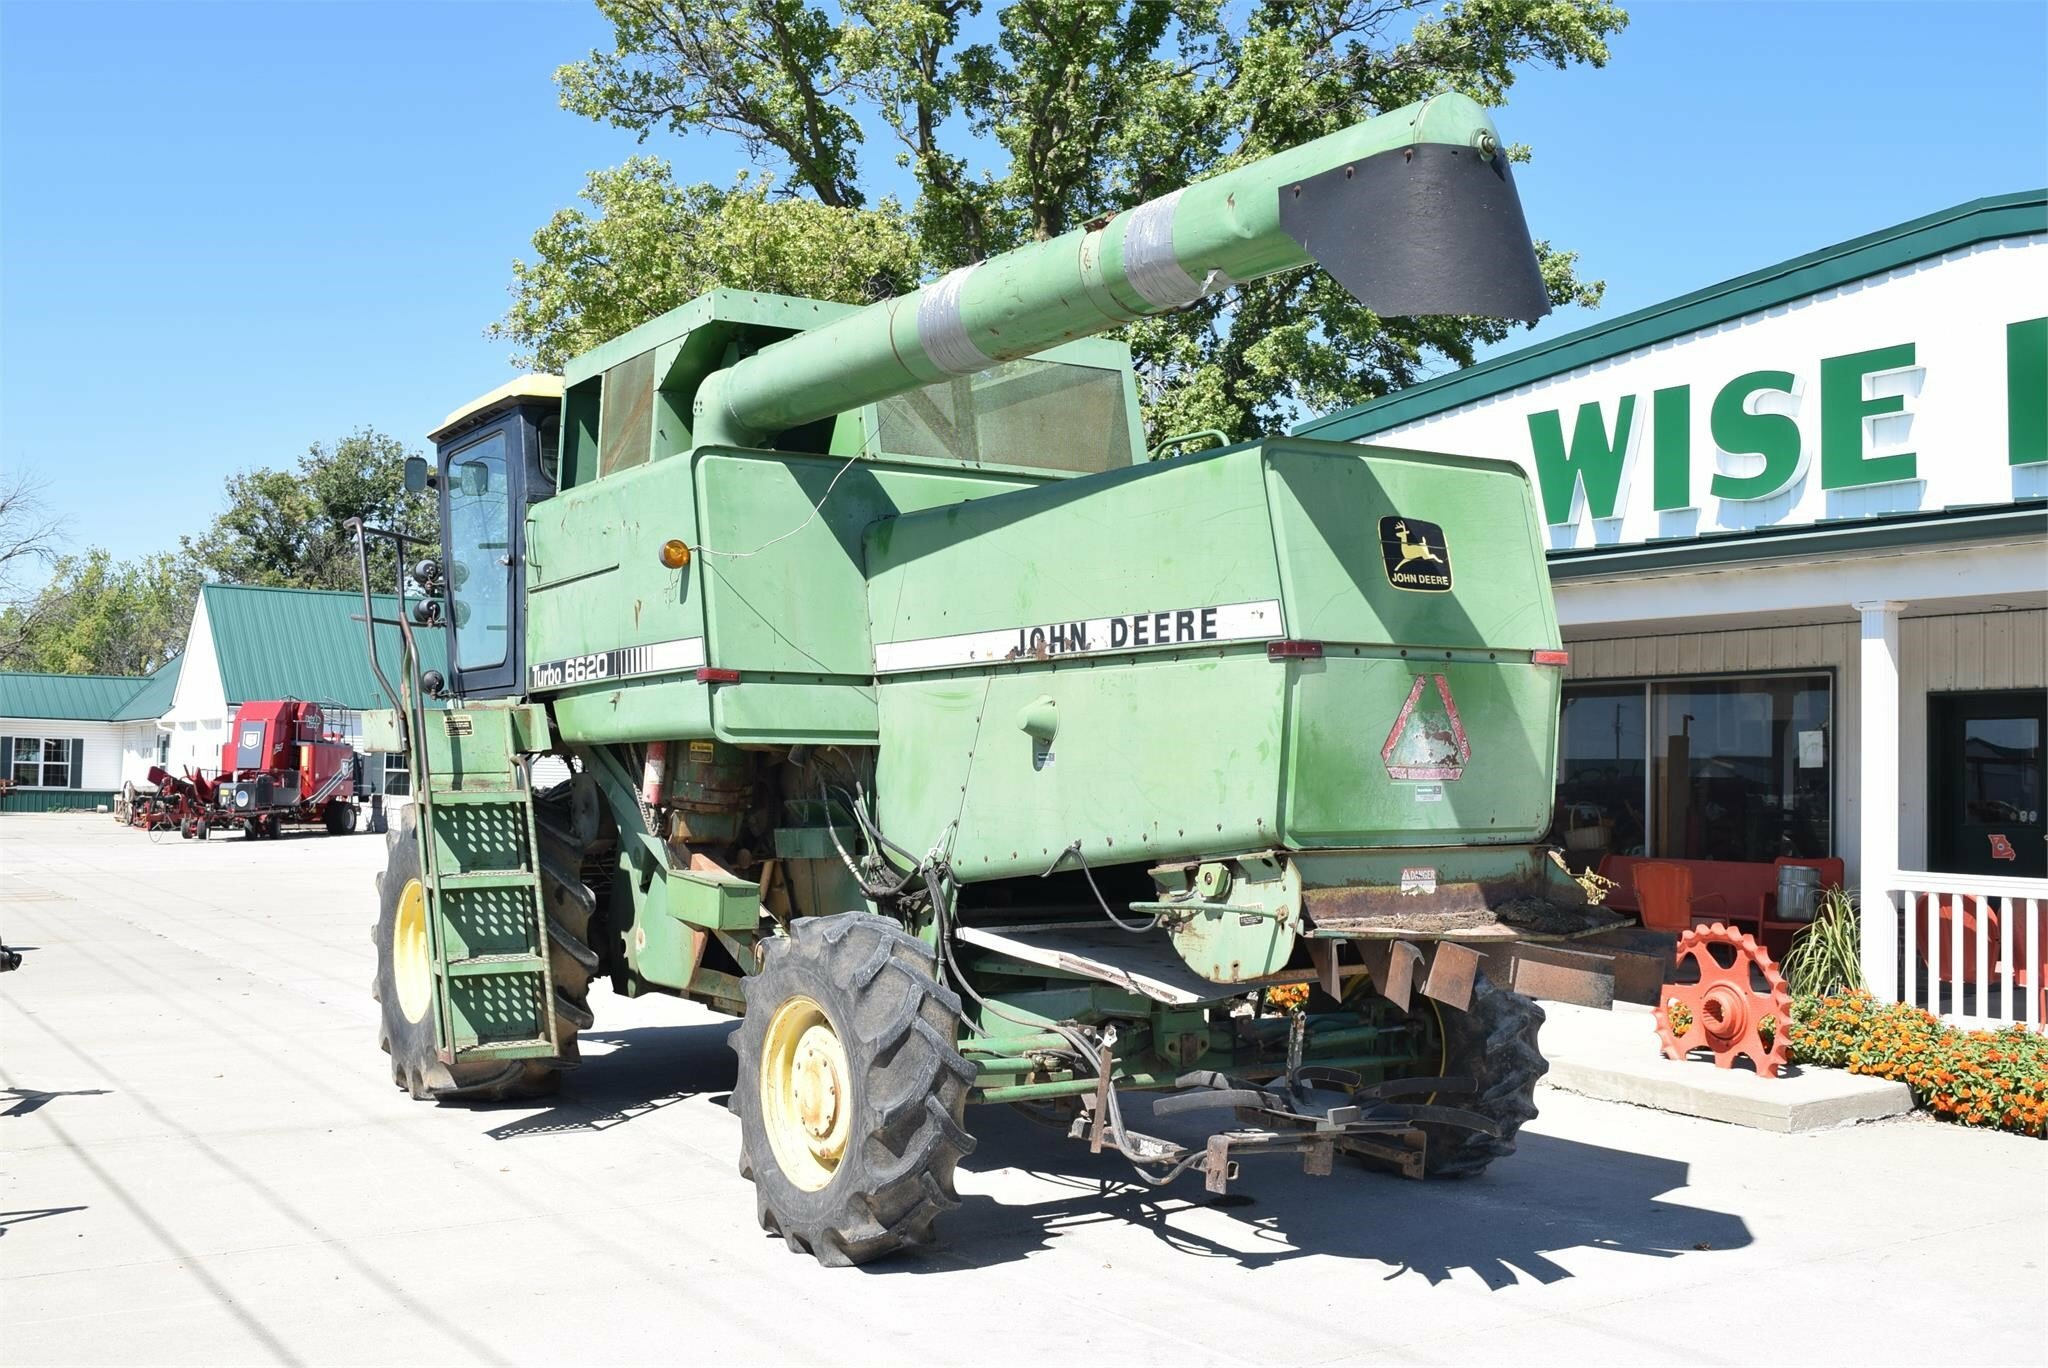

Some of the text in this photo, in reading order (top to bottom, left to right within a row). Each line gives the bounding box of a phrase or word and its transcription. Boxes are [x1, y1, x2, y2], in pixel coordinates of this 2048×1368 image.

[1528, 342, 1917, 525] WISE
[1393, 573, 1449, 586] JOHN DEERE
[1015, 608, 1217, 657] JOHN DEERE
[532, 653, 608, 688] Turbo 6620
[1410, 870, 1435, 880] DANGER
